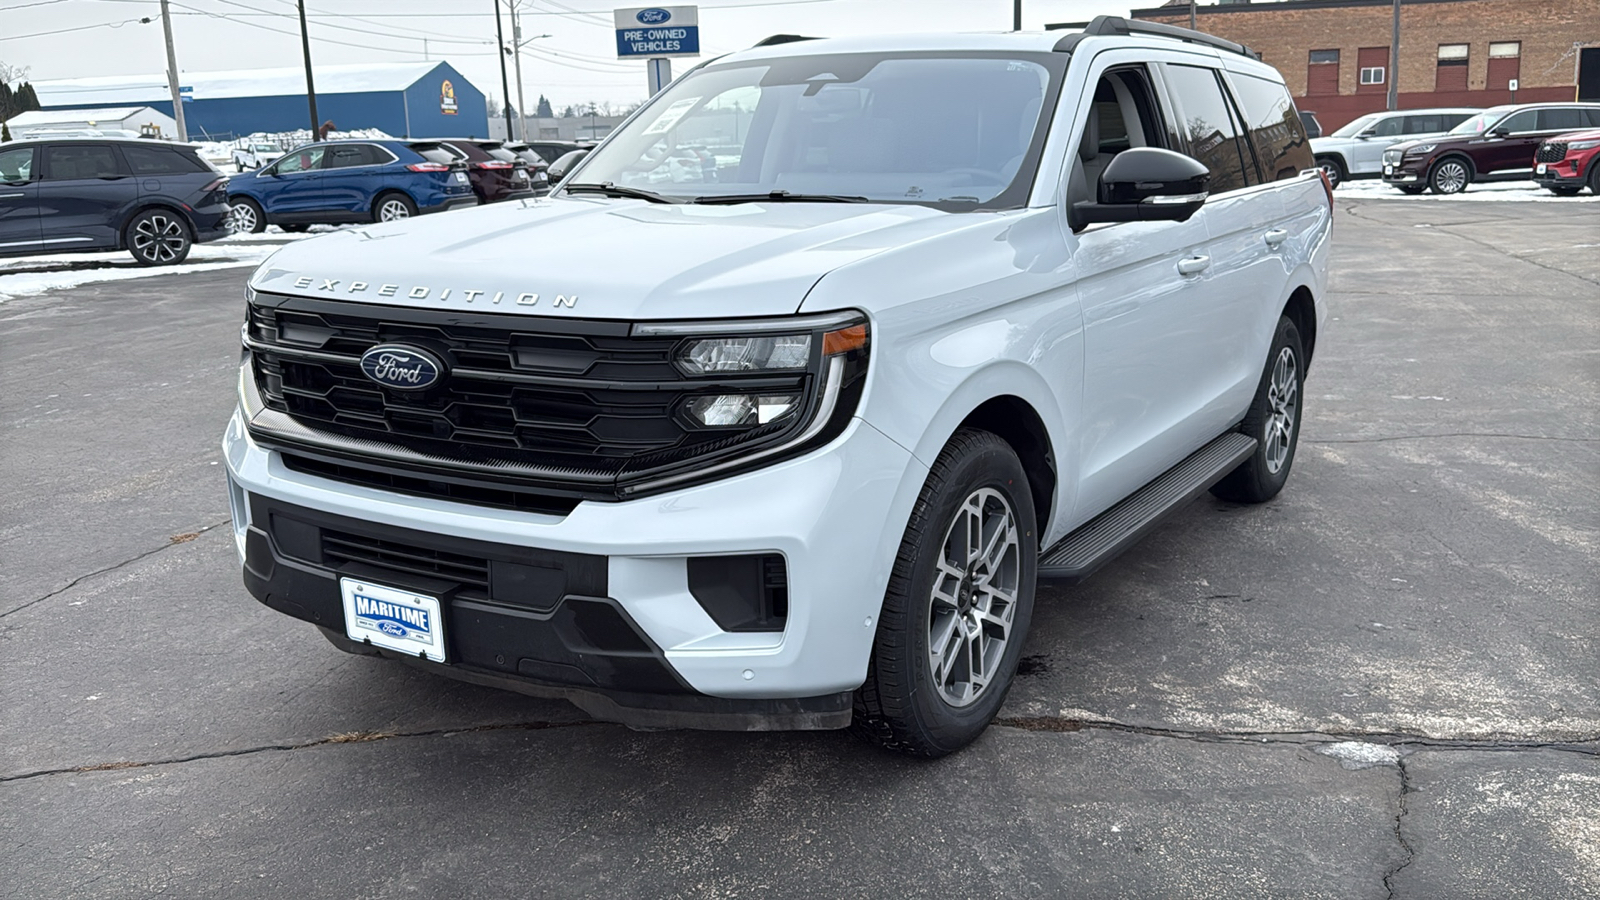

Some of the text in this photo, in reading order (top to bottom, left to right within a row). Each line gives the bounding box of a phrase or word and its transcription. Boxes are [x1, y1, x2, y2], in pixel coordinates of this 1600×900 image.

[642, 11, 663, 22] Ford
[624, 29, 687, 41] PRE-OWNED
[631, 41, 681, 52] VEHICLES
[294, 276, 578, 308] EXPEDITION
[374, 353, 421, 384] Ford
[356, 596, 429, 631] MARITIME
[382, 622, 403, 636] Ford
